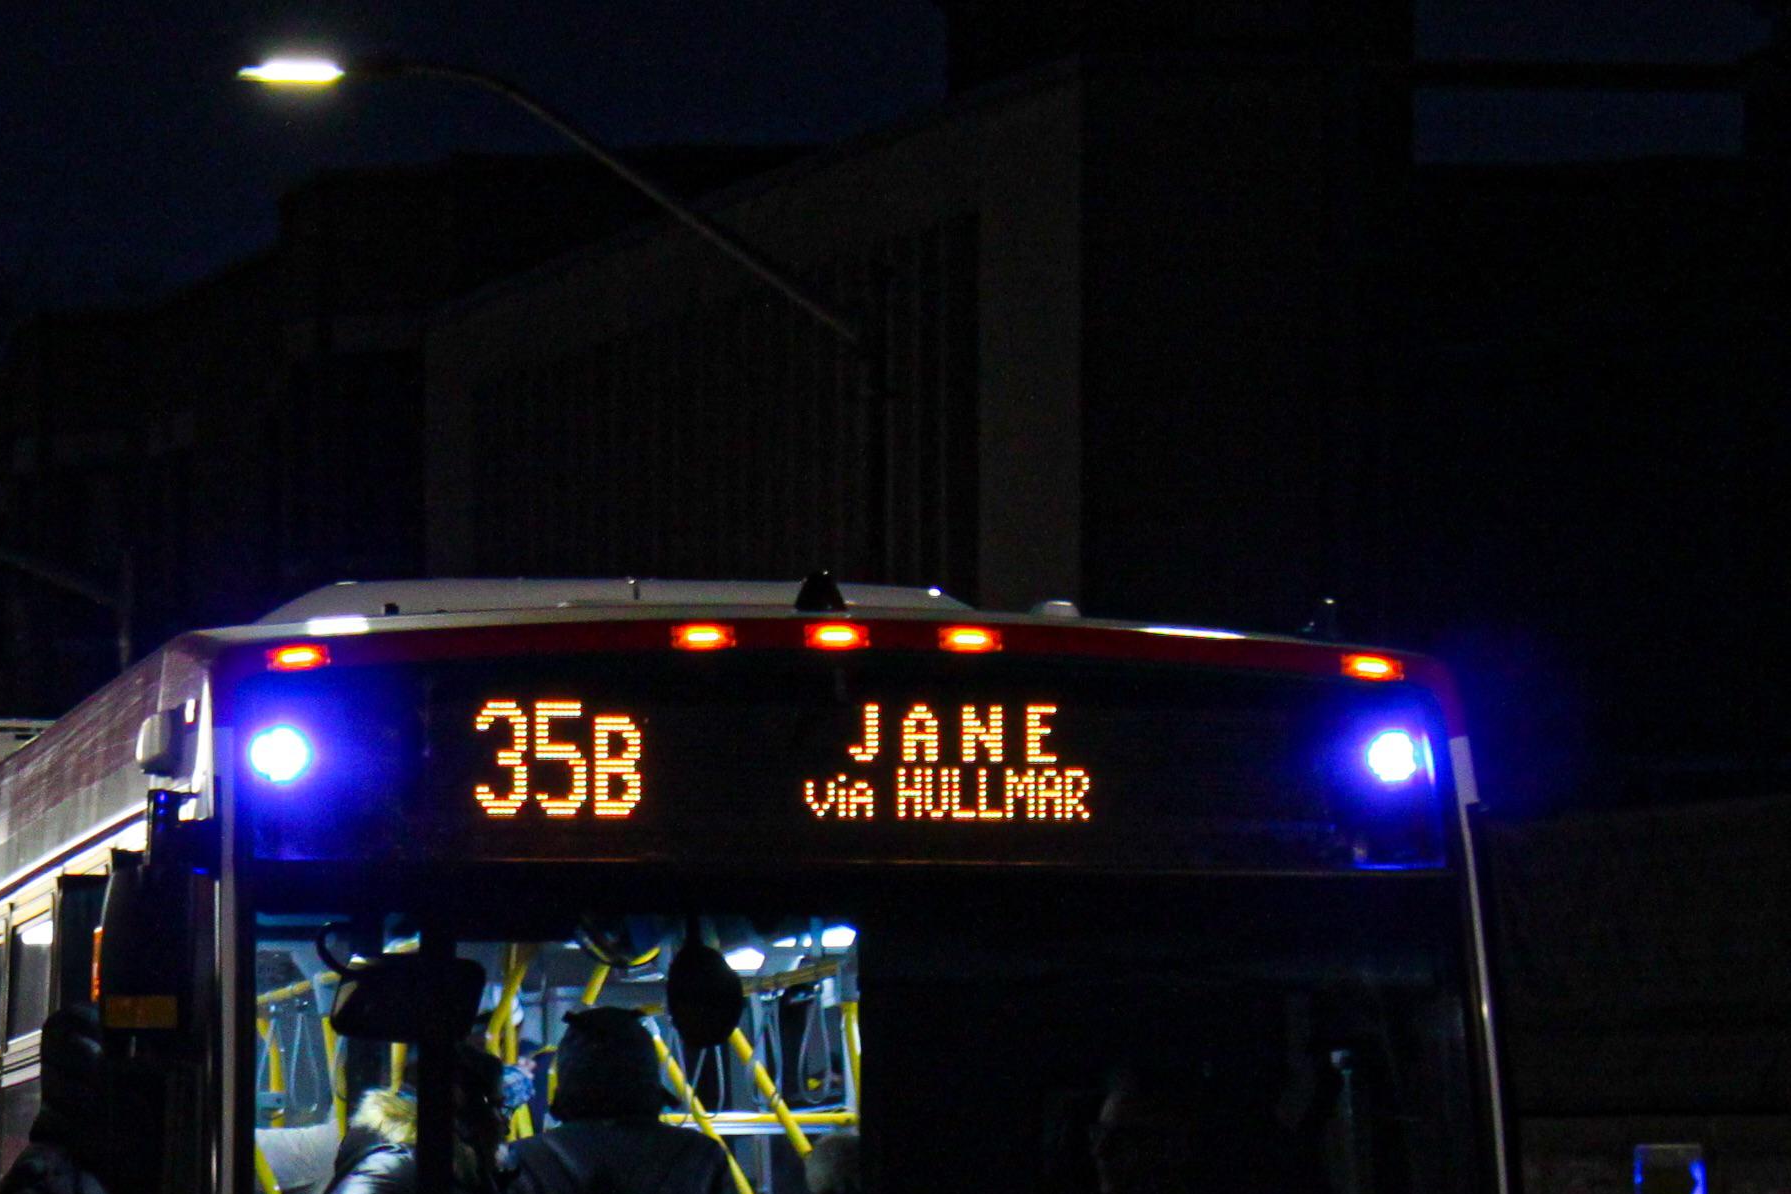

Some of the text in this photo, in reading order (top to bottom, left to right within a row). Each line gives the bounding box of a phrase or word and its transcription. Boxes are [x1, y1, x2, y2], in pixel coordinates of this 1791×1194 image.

[473, 698, 643, 817] 35B
[847, 702, 1058, 764] JANE
[896, 767, 1090, 820] HULLMAR
